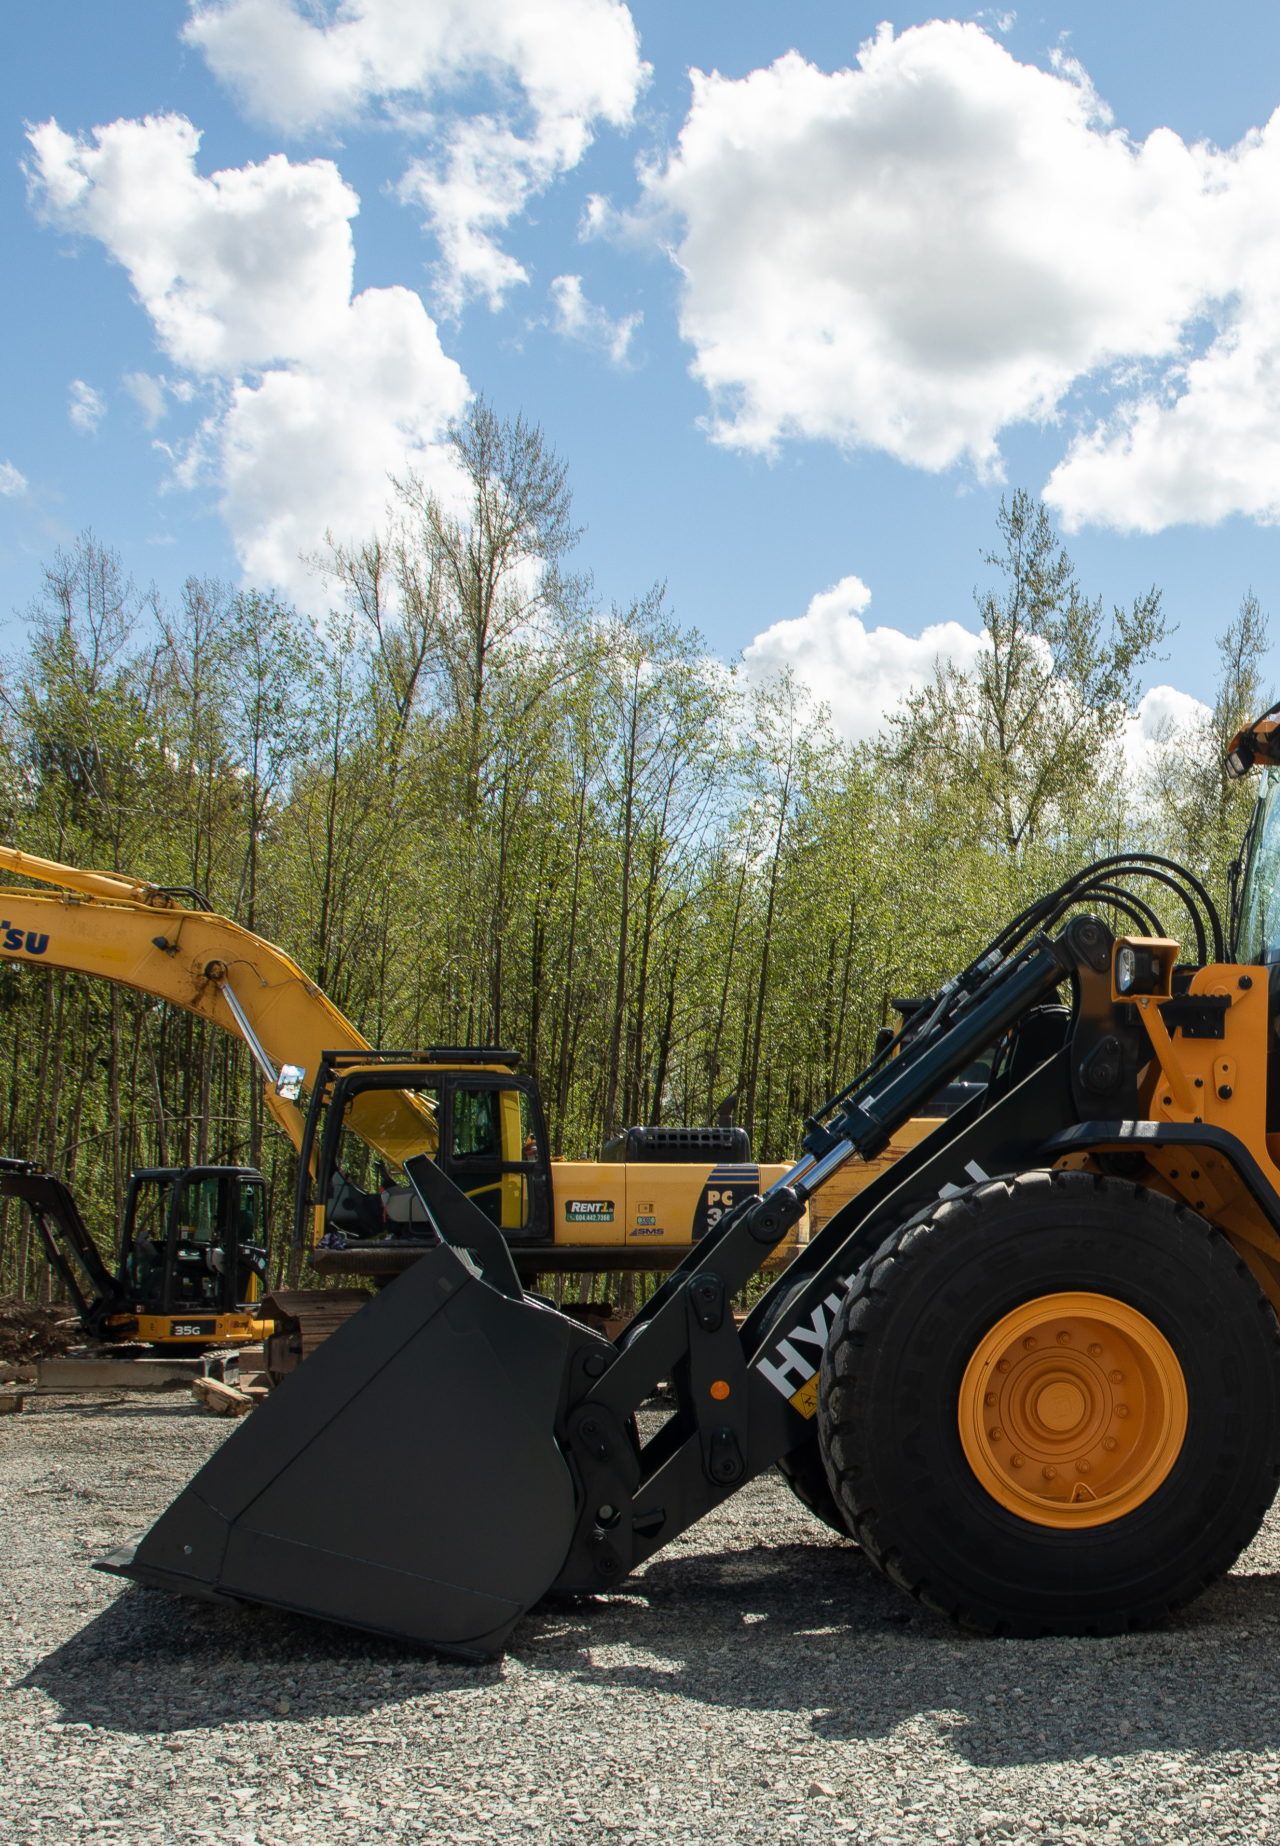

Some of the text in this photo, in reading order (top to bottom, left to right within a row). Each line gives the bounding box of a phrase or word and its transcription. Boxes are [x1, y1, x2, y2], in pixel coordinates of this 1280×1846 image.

[708, 1190, 733, 1206] PC
[707, 1208, 735, 1227] 3
[174, 1325, 201, 1336] 35G
